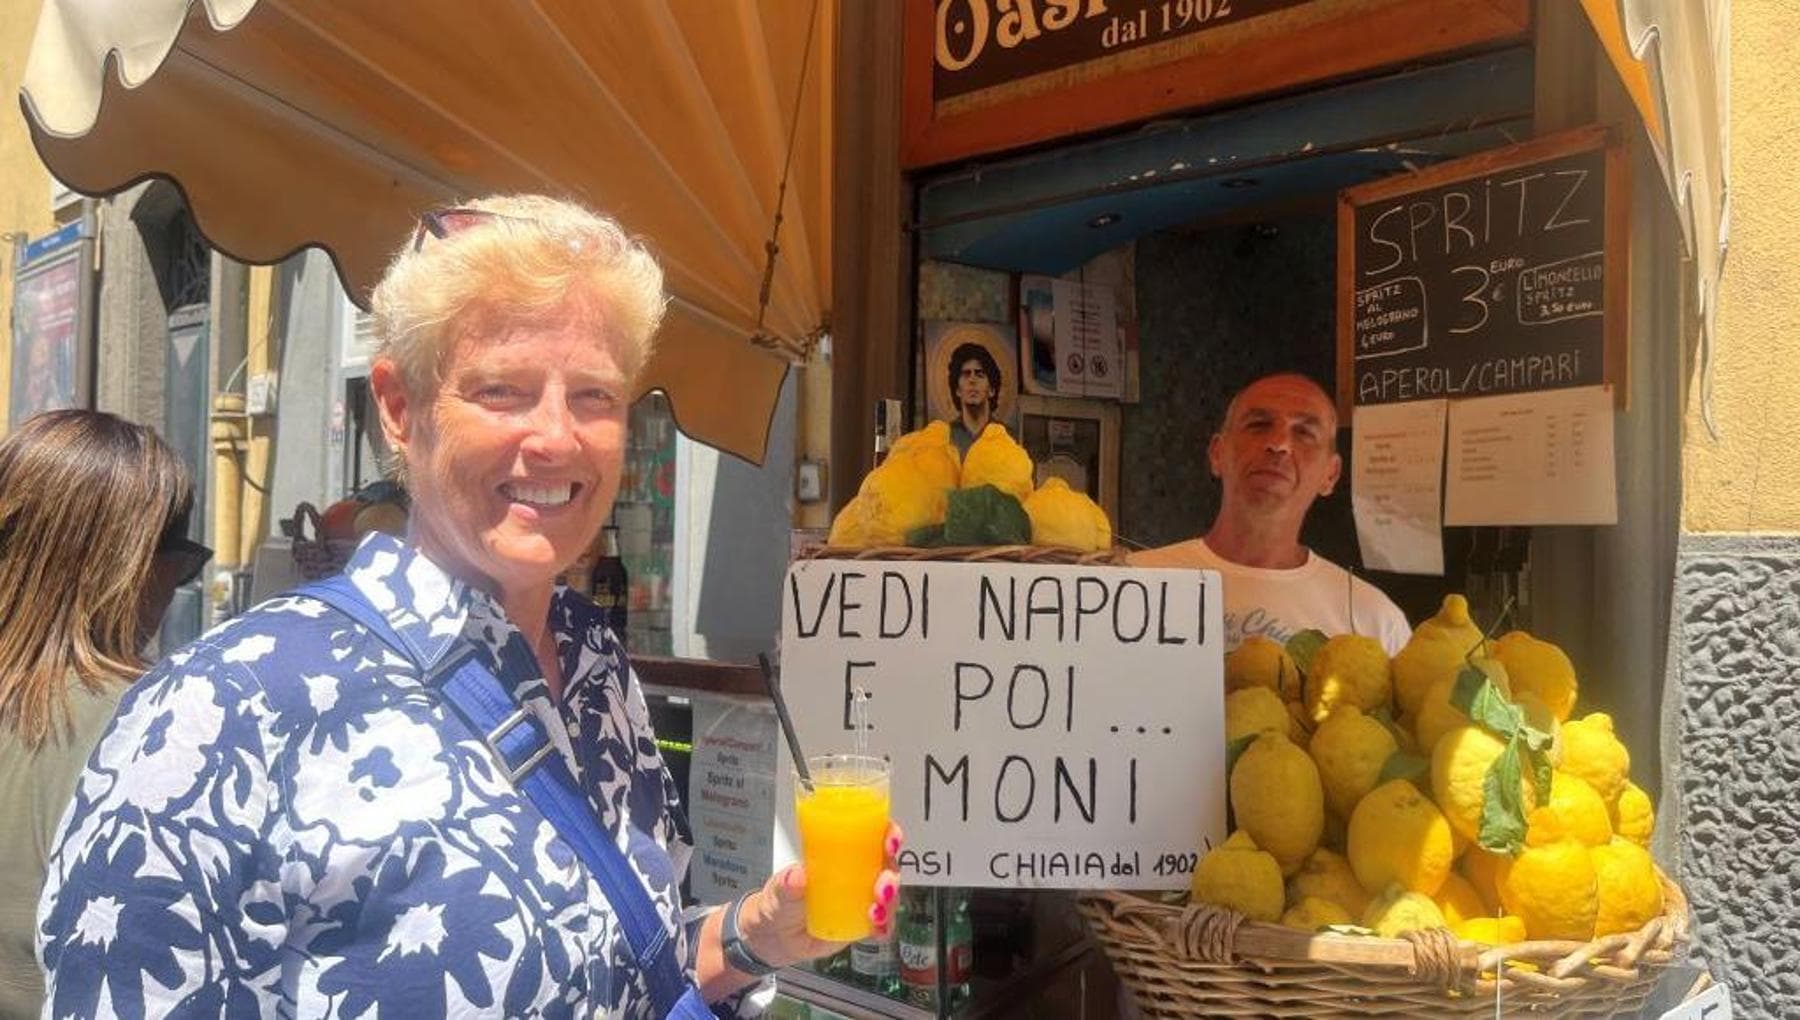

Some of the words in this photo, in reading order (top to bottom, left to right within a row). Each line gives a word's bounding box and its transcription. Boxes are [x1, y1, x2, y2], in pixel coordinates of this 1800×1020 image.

[936, 0, 1108, 71] Oas
[1101, 9, 1147, 48] dal
[1161, 0, 1232, 32] 1902
[1366, 170, 1590, 275] SPRITZ
[1356, 285, 1402, 306] SPRITZ
[1367, 304, 1382, 313] AL
[1449, 266, 1490, 333] 3
[1490, 257, 1525, 273] EURO
[1525, 286, 1575, 305] SPRITZ
[1359, 349, 1580, 402] APEROL/CAMPARI
[791, 572, 929, 639] VEDI
[977, 575, 1207, 645] NAPOLI
[843, 661, 877, 731] E
[826, 753, 1137, 825] MONI
[898, 850, 951, 876] ASI
[990, 852, 1105, 879] CHIAIA
